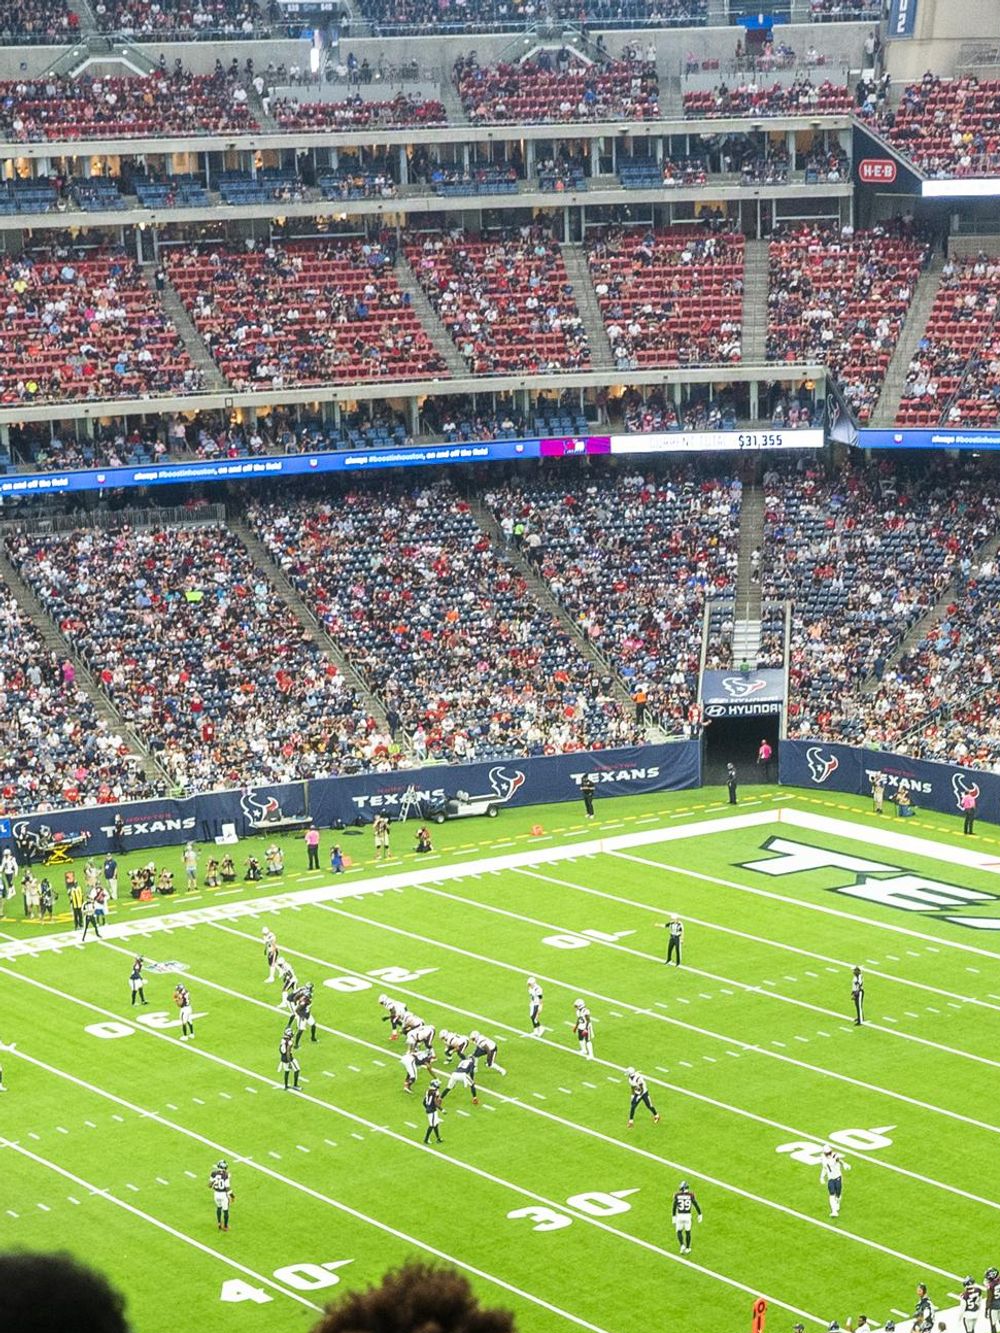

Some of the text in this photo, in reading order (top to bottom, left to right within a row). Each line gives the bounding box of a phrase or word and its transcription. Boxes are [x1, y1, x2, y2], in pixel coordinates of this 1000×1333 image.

[570, 767, 660, 785] TEXANS
[323, 966, 421, 993] 20
[775, 1128, 893, 1165] 20
[507, 1191, 632, 1232] 30
[677, 1200, 691, 1211] 39
[220, 1263, 341, 1304] 40
